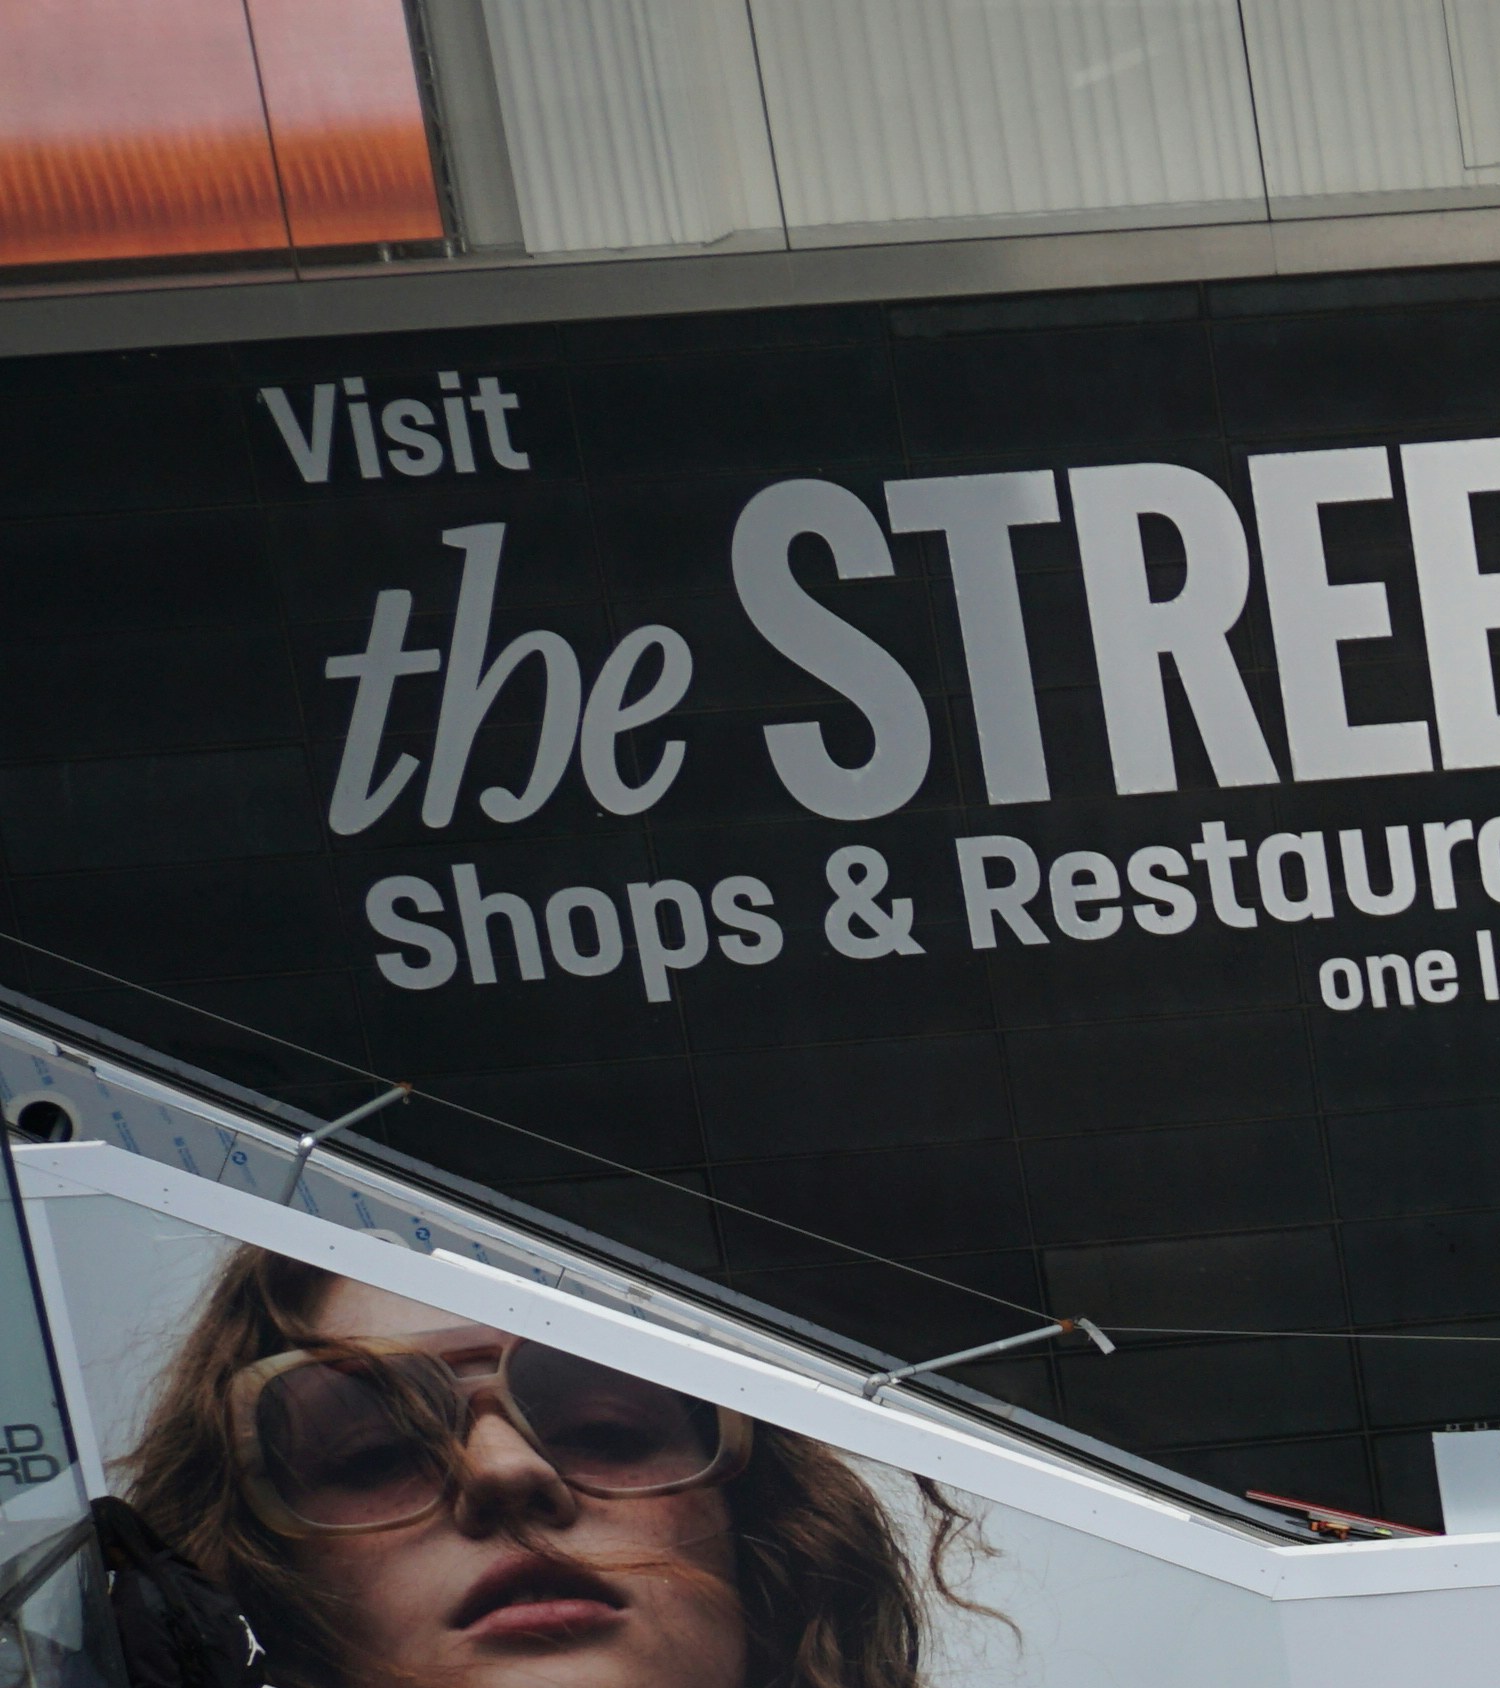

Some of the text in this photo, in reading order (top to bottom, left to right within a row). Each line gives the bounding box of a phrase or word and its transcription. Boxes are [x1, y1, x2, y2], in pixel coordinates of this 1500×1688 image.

[262, 372, 529, 486] Visit
[325, 525, 692, 837] the
[365, 867, 783, 1002] Shops
[825, 844, 922, 961] &
[1318, 939, 1459, 1011] one
